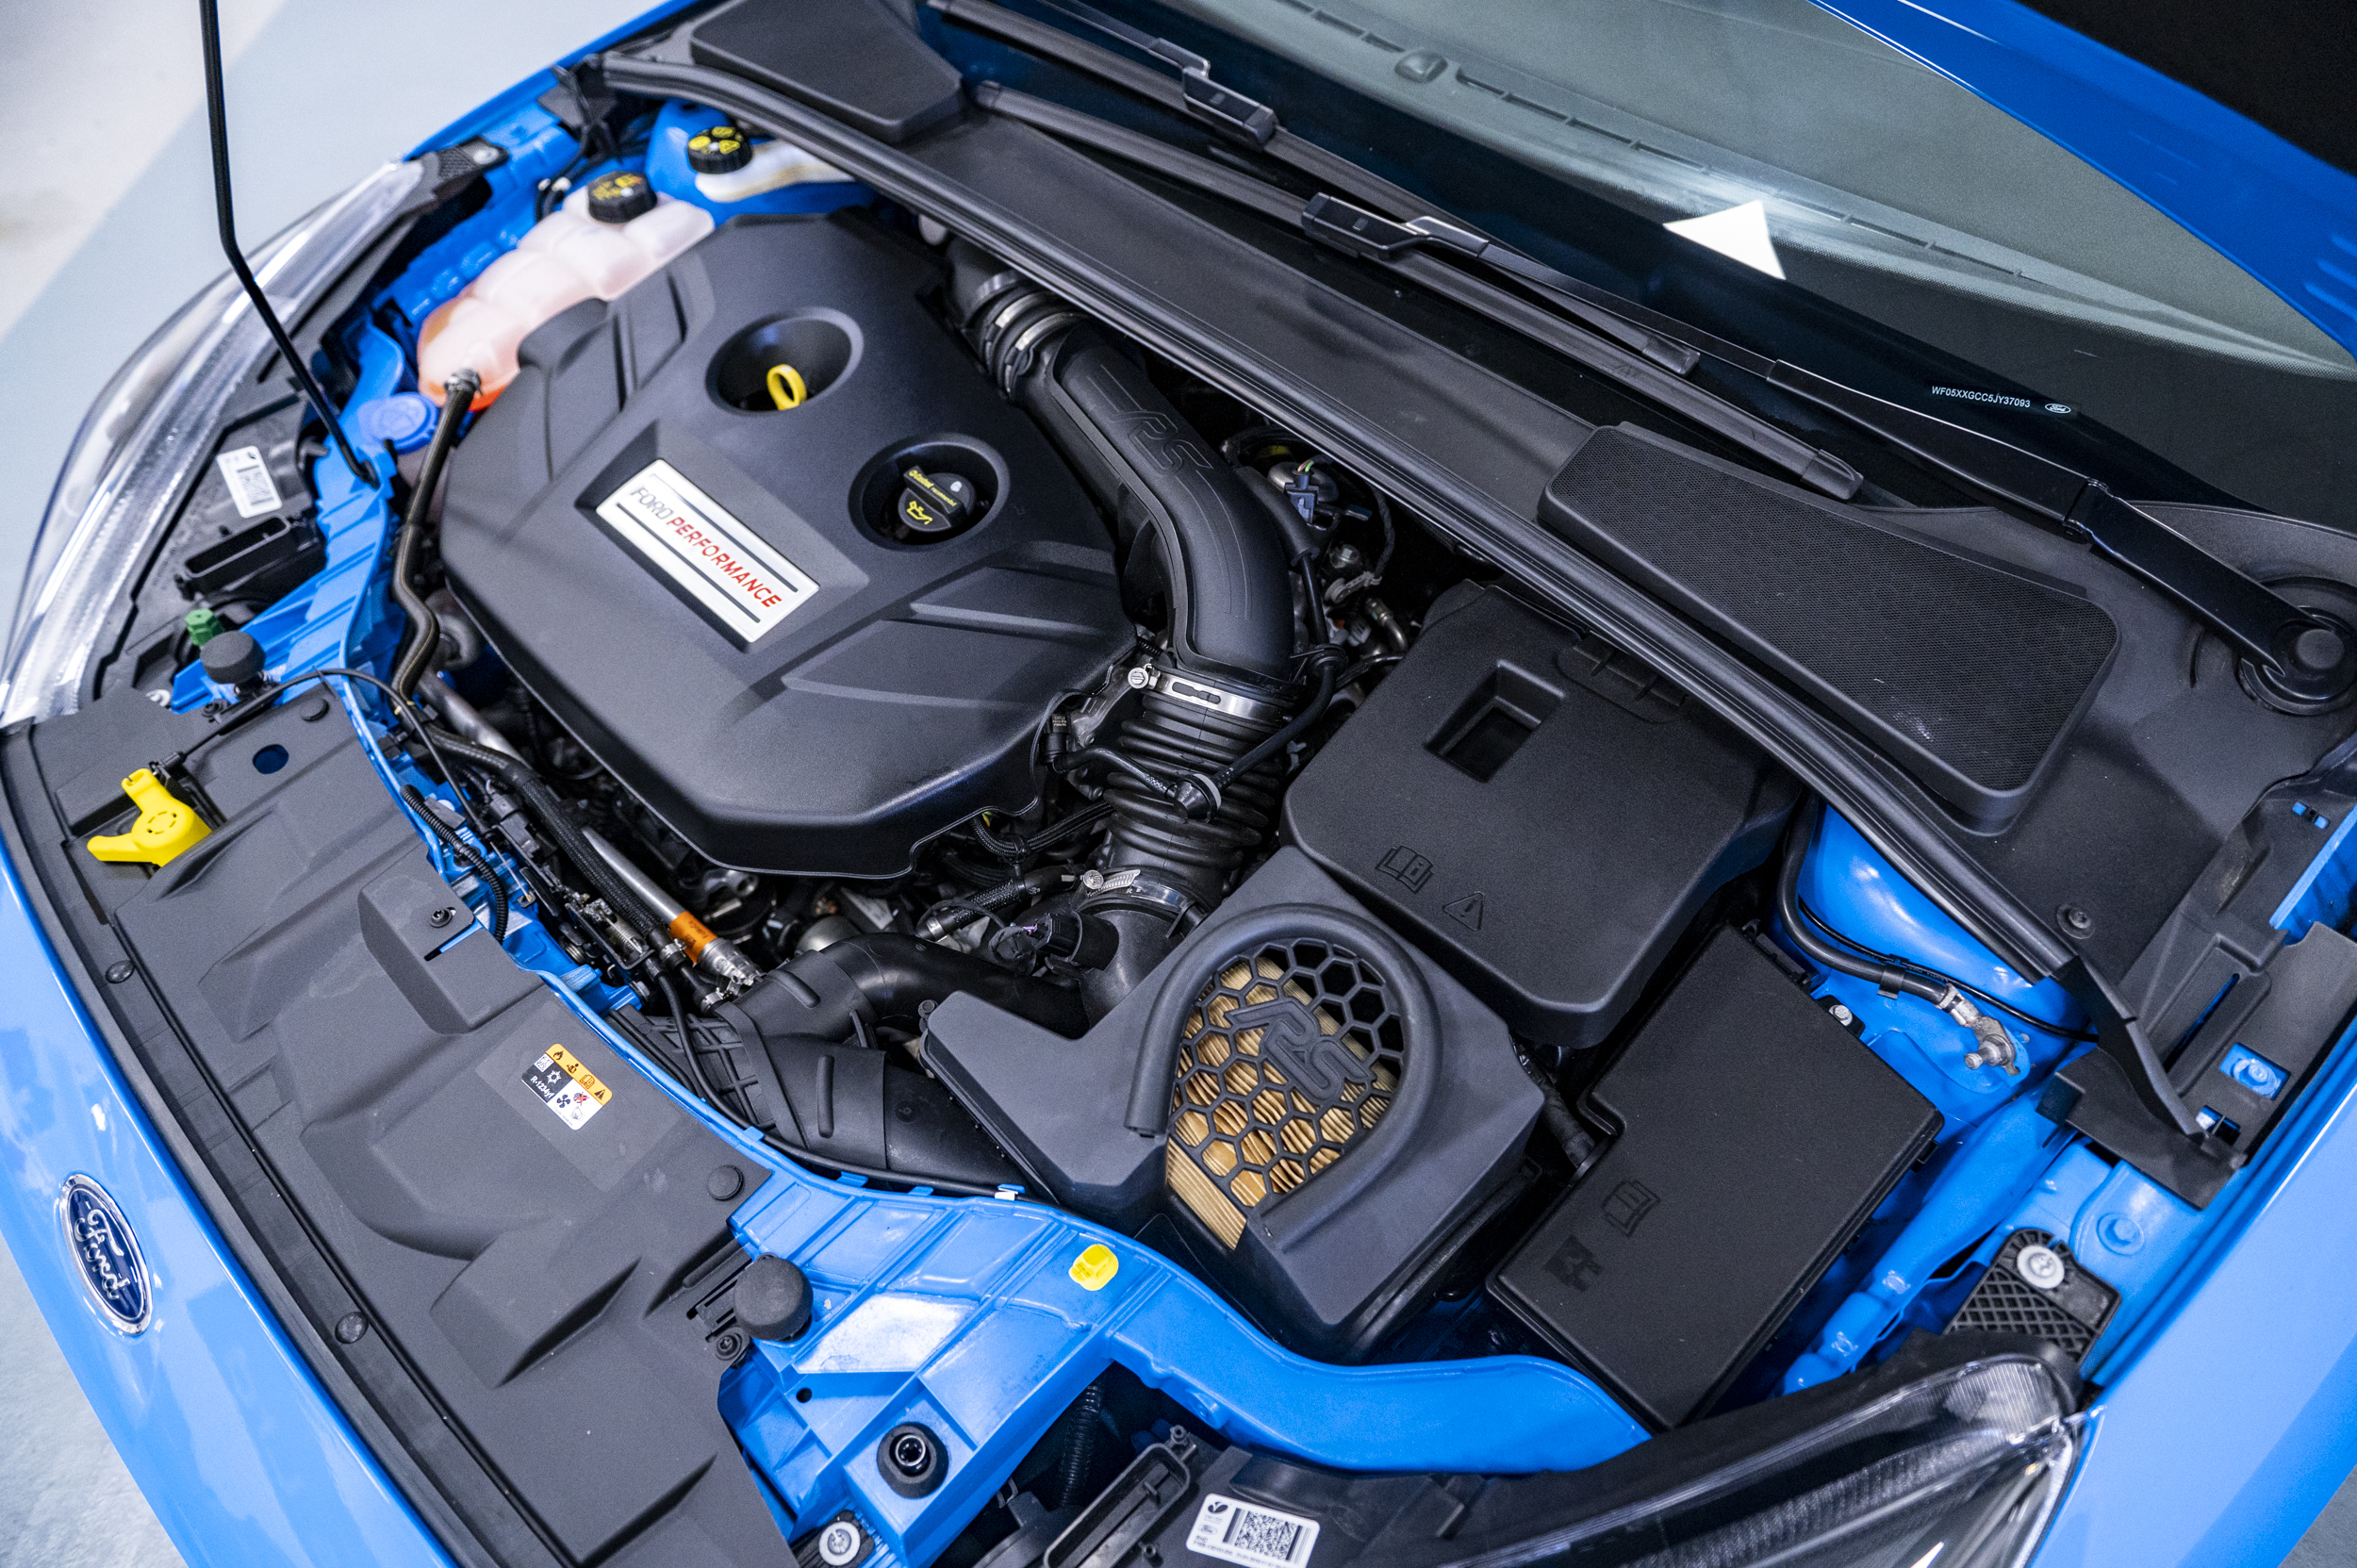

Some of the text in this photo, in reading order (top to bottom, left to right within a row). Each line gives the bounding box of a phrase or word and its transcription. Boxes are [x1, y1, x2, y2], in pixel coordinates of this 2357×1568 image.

[1932, 386, 2031, 408] WF05XXGCC5JY37093
[631, 486, 782, 608] FORD PERFORMANCE
[530, 1075, 555, 1099] R-1234yf
[1226, 999, 1370, 1101] RS
[74, 1209, 131, 1300] Ford
